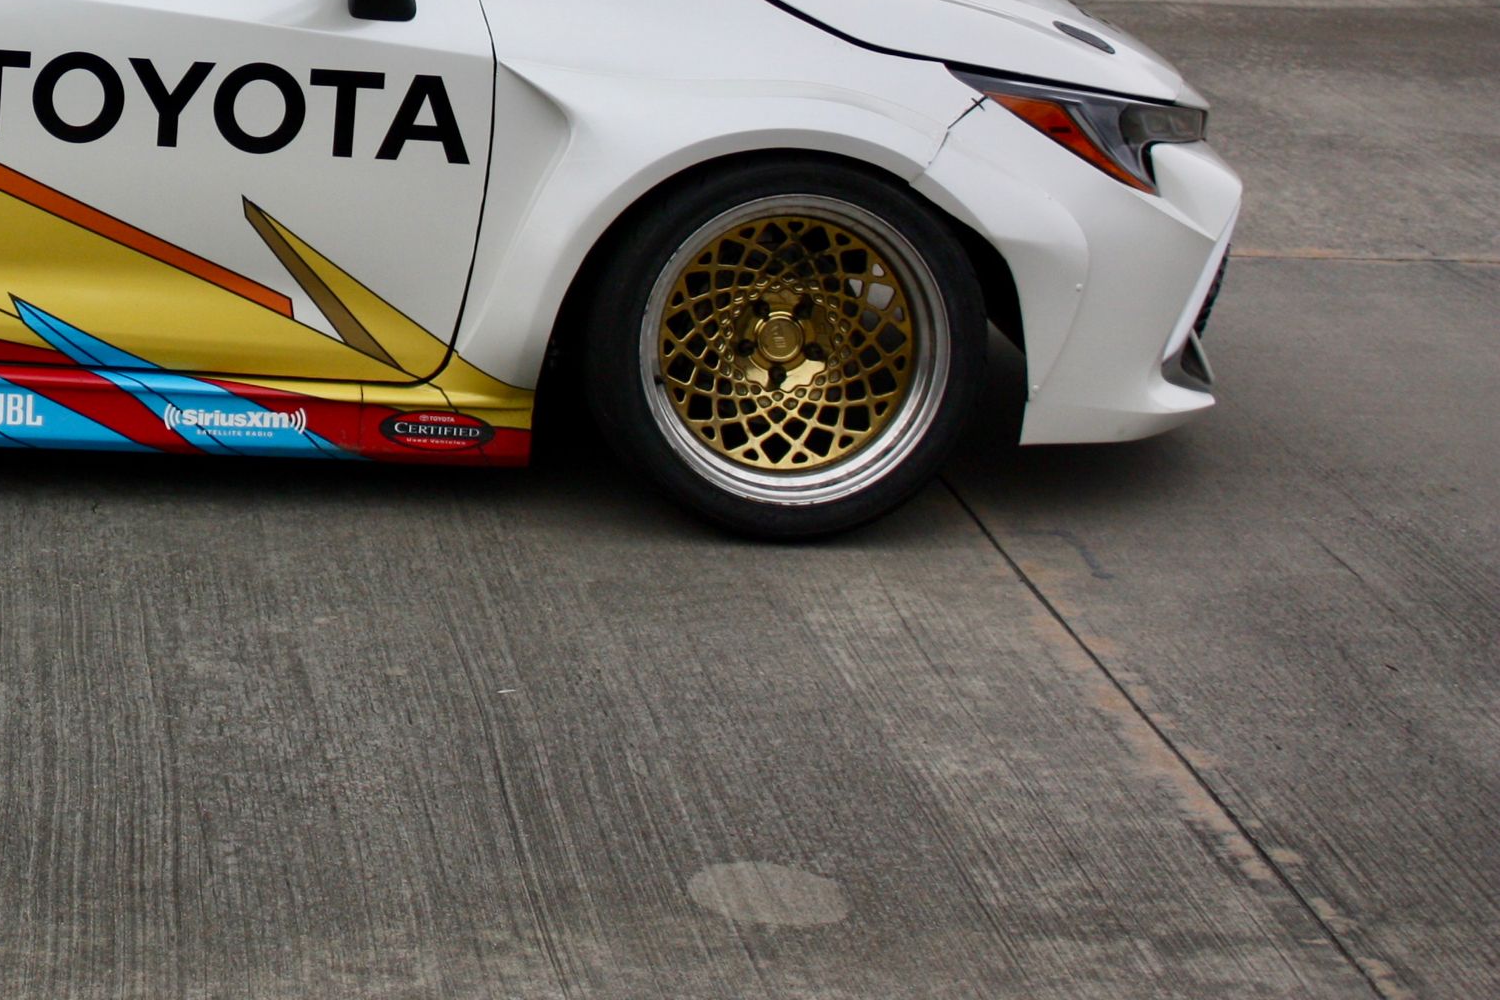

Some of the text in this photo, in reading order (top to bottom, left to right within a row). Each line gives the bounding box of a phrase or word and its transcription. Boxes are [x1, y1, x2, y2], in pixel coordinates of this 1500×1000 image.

[429, 415, 455, 423] TOYOTA
[196, 429, 273, 438] SATELLITE RADIO
[394, 421, 480, 438] CERTIFIED
